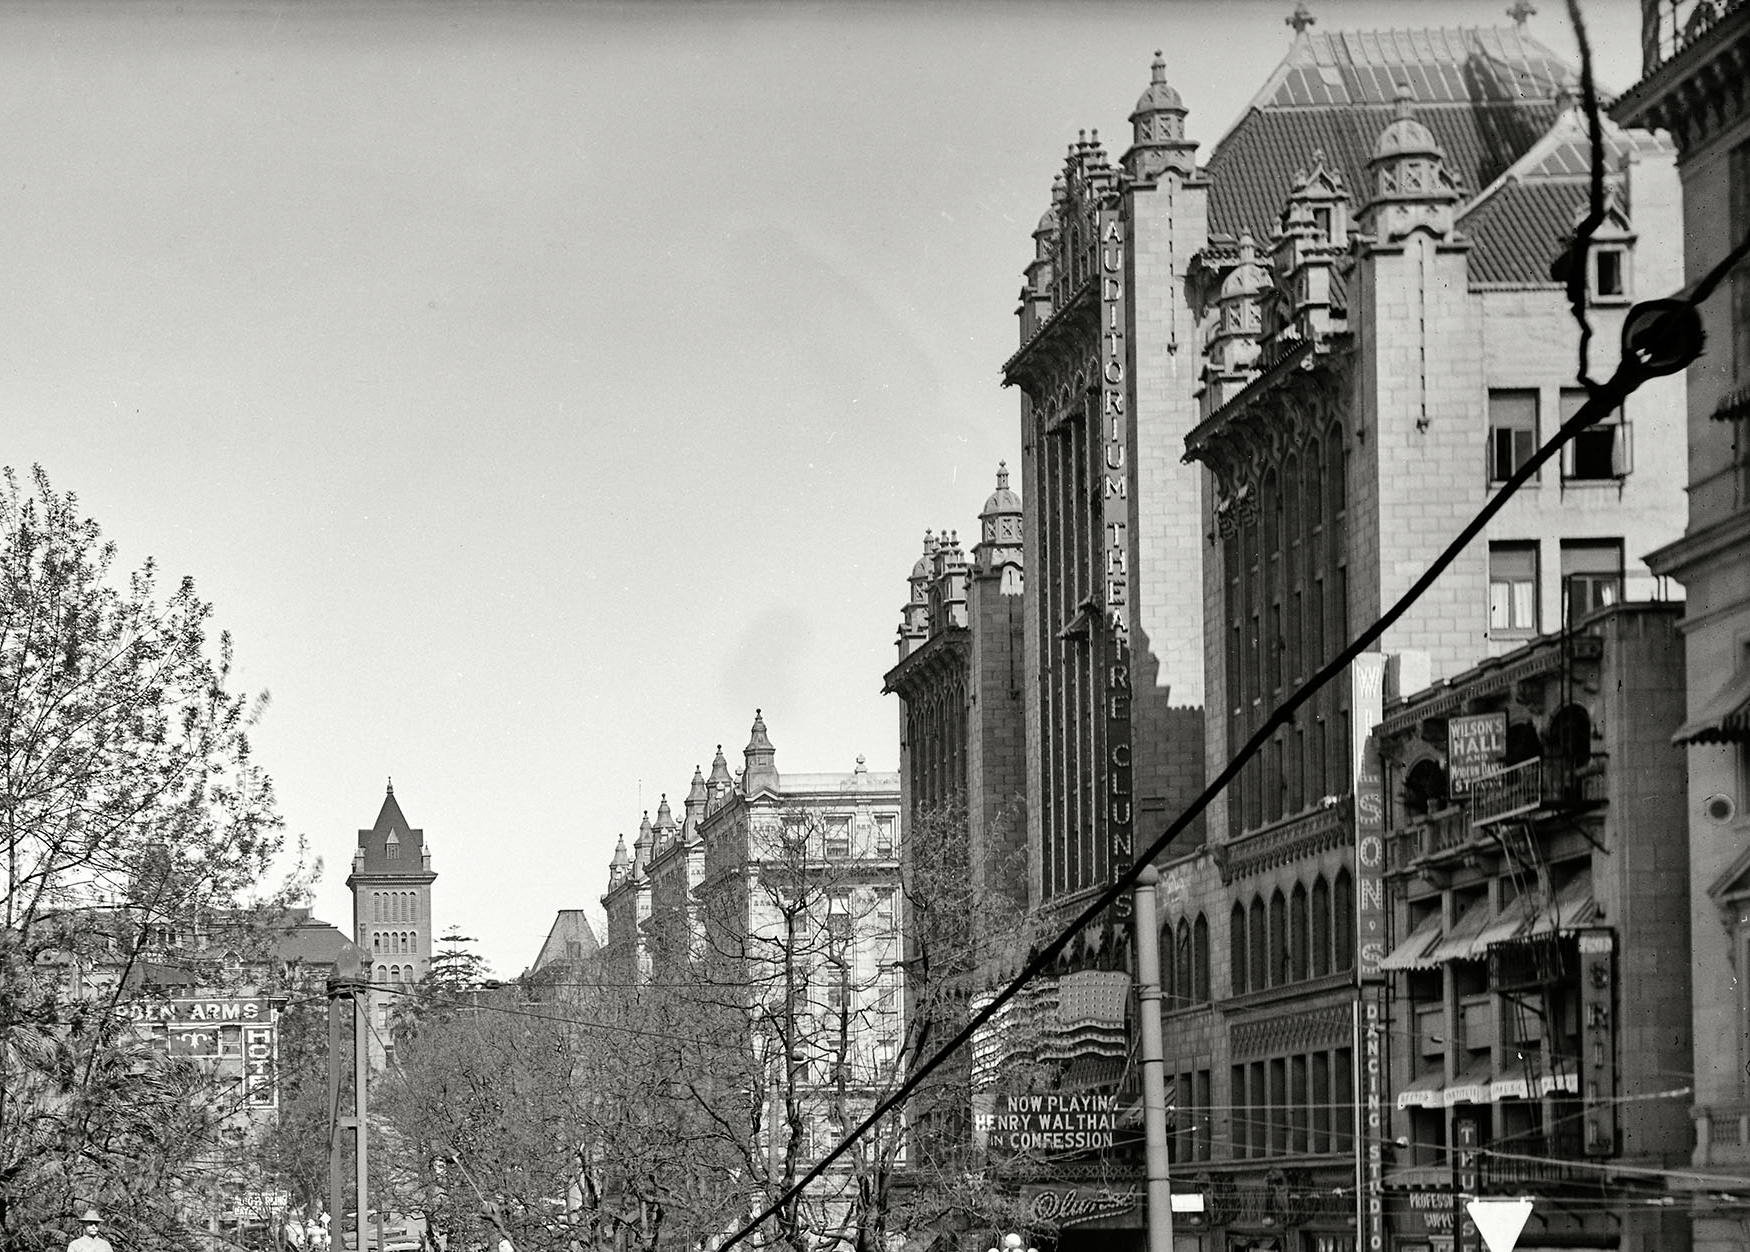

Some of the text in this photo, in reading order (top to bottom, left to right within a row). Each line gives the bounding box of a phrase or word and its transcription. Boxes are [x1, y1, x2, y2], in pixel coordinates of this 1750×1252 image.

[1103, 219, 1127, 499] AUDITORIUM
[1107, 522, 1130, 720] THEATRE
[1451, 718, 1503, 738] WILSON'S
[1454, 734, 1501, 756] HALL
[1466, 753, 1488, 763] AND
[190, 1003, 259, 1021] ARMS
[1366, 1004, 1380, 1128] DANCING
[1008, 1095, 1042, 1113] NOW
[975, 1113, 1031, 1131] HENRY
[1010, 1132, 1113, 1149] CONFESSION
